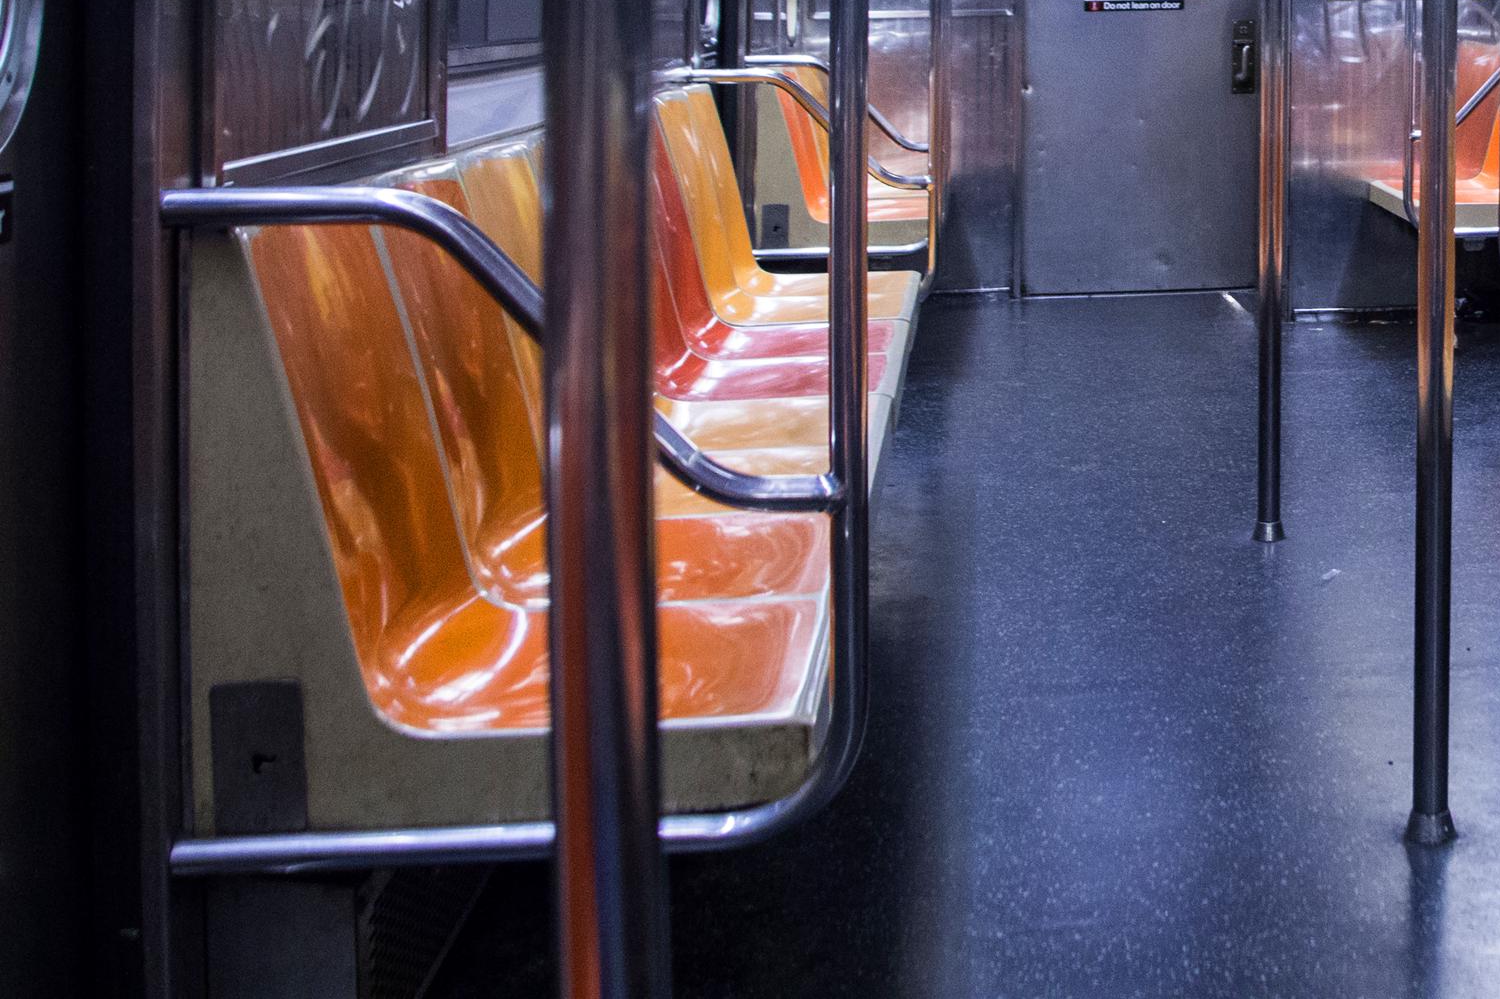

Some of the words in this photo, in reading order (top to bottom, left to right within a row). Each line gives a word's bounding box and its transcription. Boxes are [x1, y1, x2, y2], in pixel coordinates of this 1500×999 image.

[1103, 1, 1115, 10] Do
[1116, 1, 1130, 10] not
[1131, 1, 1149, 10] lean
[1161, 0, 1180, 9] door
